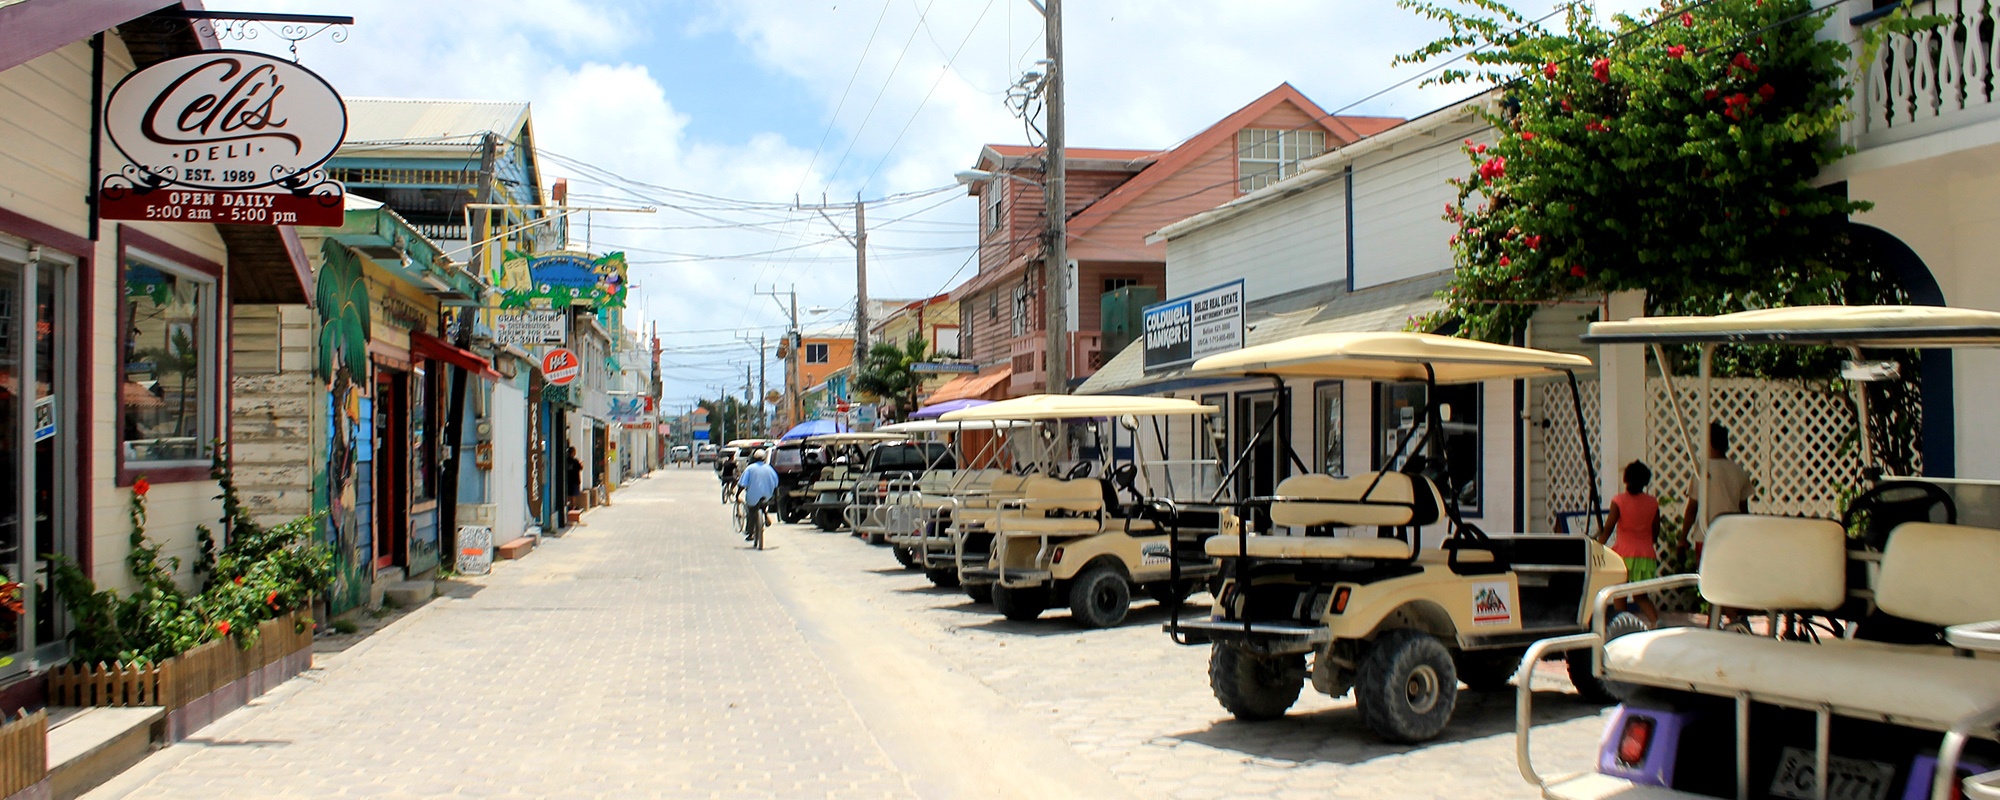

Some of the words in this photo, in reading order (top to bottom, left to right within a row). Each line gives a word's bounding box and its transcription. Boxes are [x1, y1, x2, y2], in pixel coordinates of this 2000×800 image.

[141, 58, 302, 155] Celi's
[185, 143, 252, 163] DELI
[185, 168, 215, 182] EST.
[223, 169, 256, 183] 1989
[169, 191, 215, 206] OPEN
[222, 194, 276, 208] DAILY
[146, 205, 182, 219] 5:00
[187, 208, 212, 220] am
[231, 208, 267, 222] 5:00
[272, 211, 298, 224] pm
[1194, 300, 1209, 314] BELIZE
[1209, 296, 1221, 309] REAL
[1221, 292, 1239, 306] ESTATE
[498, 315, 523, 323] GRACE
[528, 314, 561, 322] SHRIMP
[1202, 309, 1224, 321] RETIREMENT
[1224, 305, 1239, 316] CENTER
